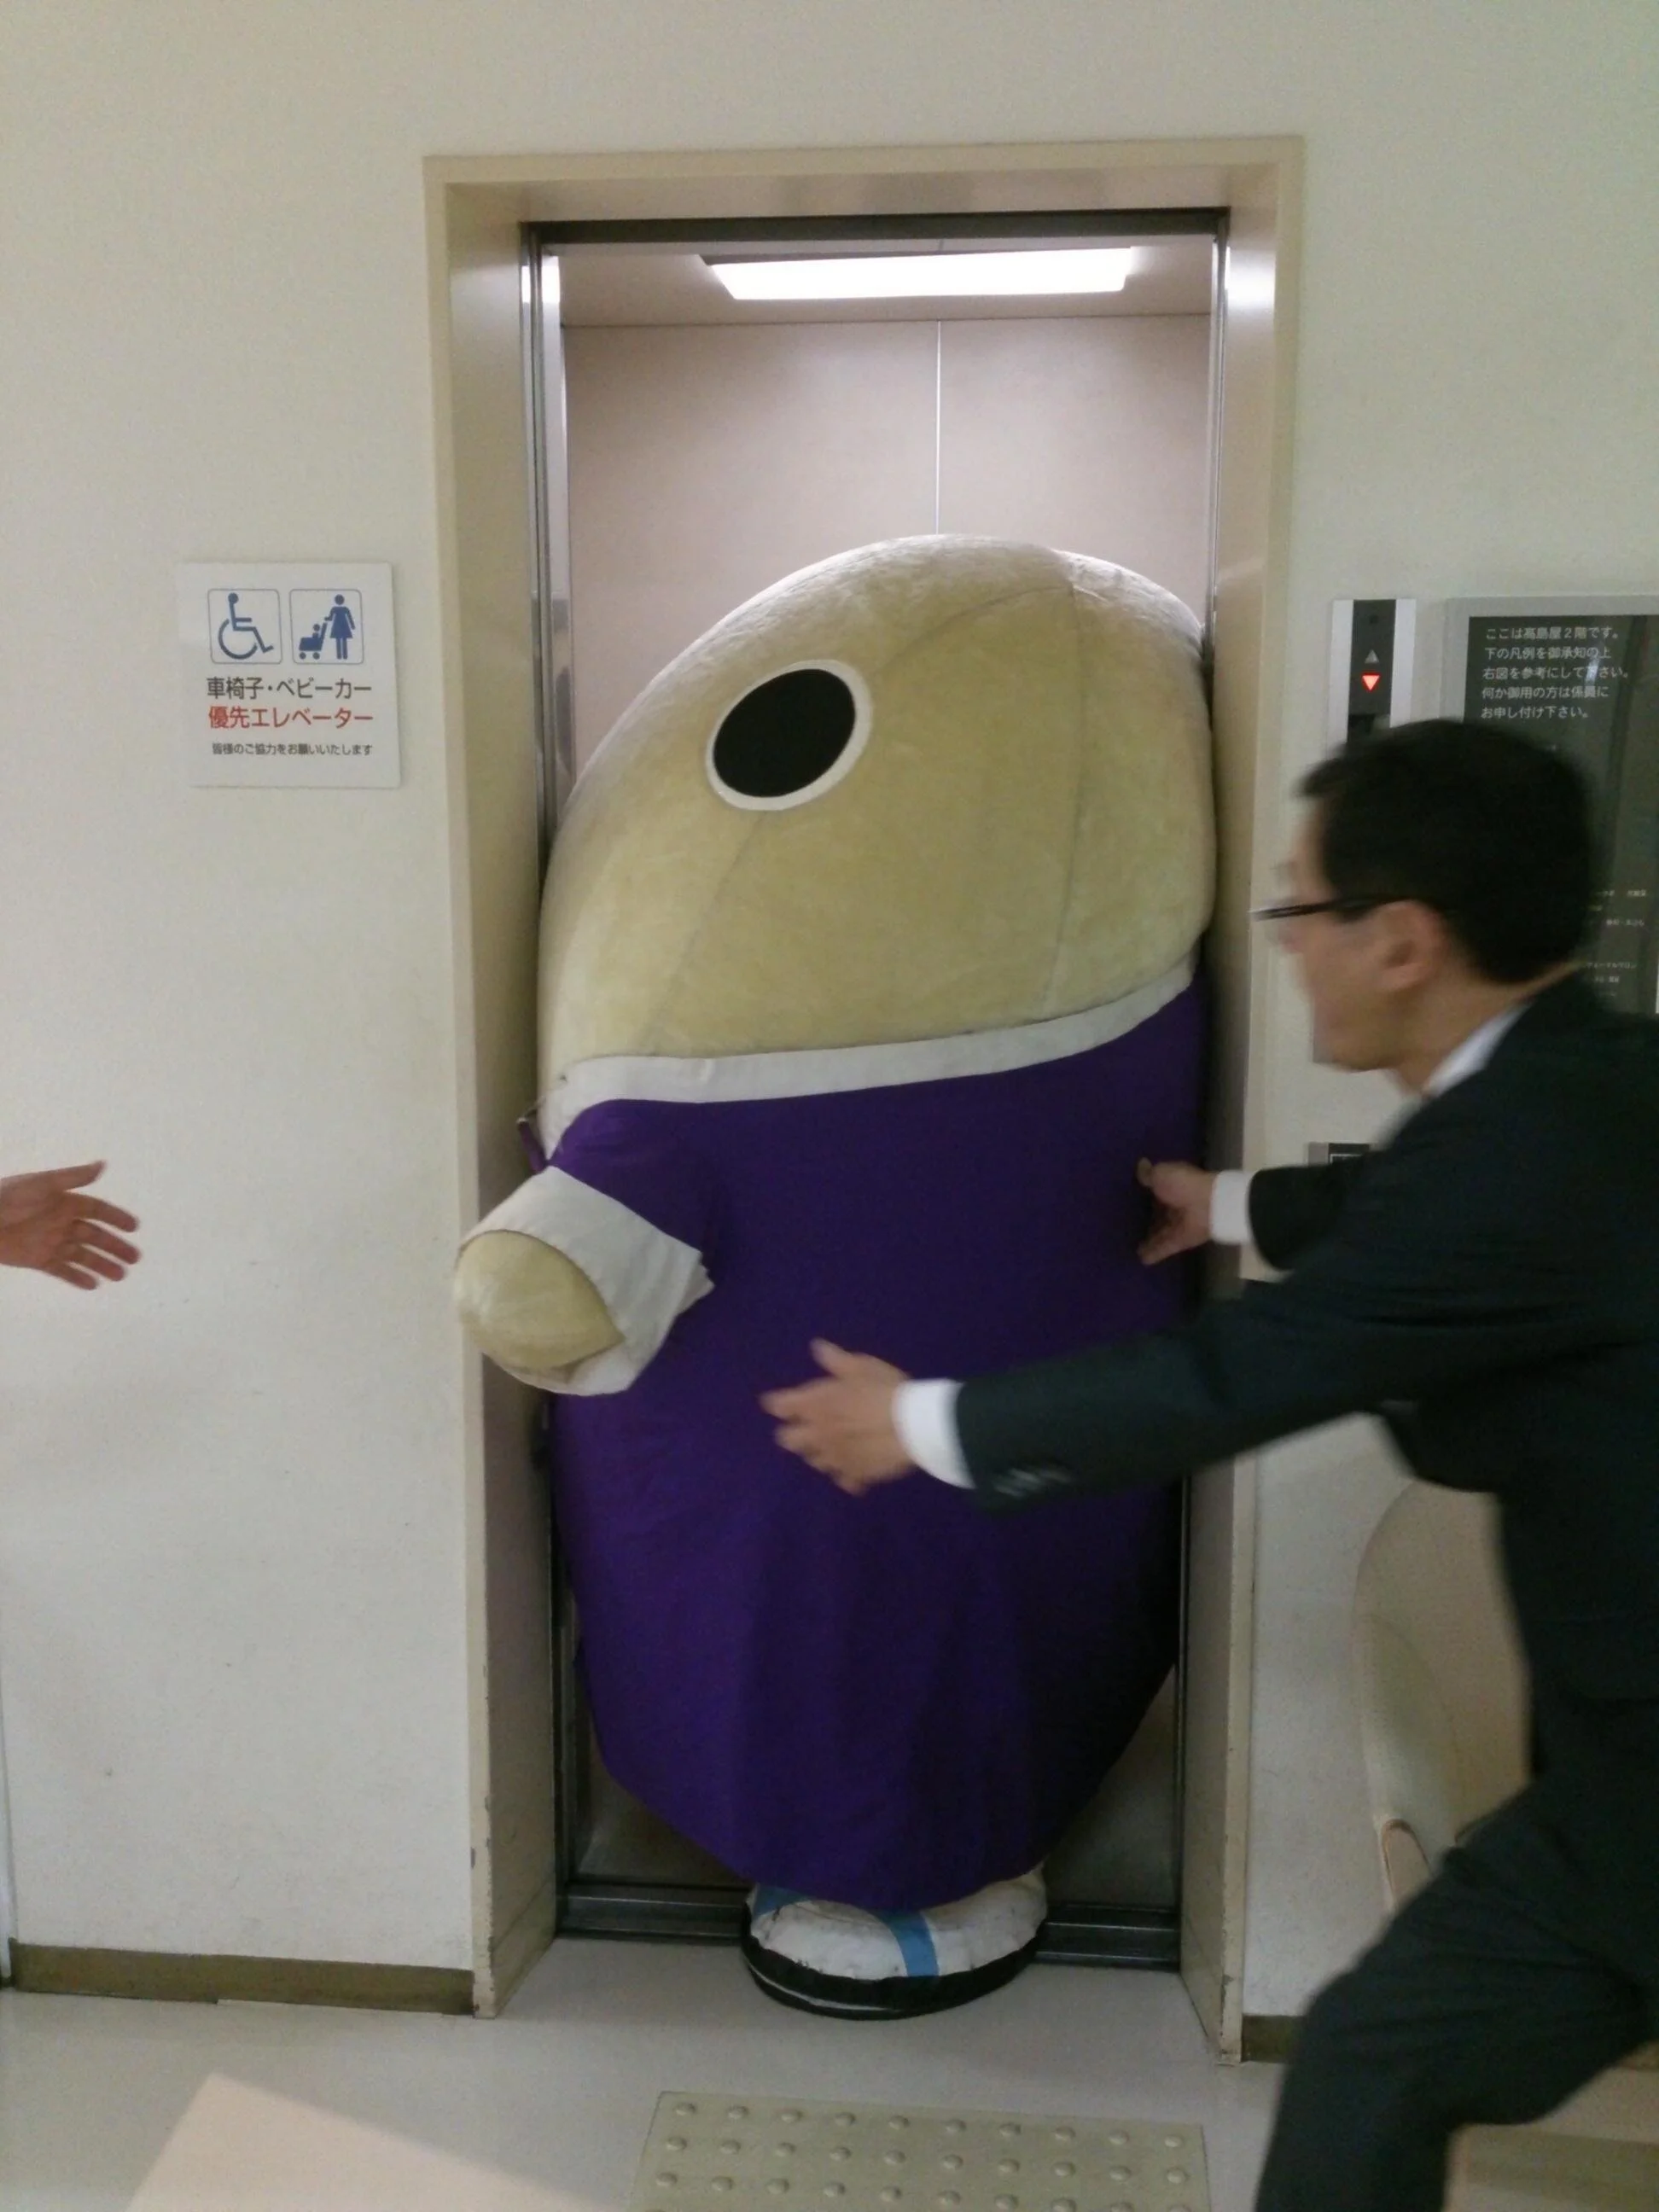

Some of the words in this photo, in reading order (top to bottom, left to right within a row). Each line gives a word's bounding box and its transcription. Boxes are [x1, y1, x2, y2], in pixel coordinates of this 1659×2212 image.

[1485, 647, 1611, 660] 下の凡例を御承知の上
[207, 676, 371, 700] 車椅子・ベビーカー
[1481, 686, 1610, 700] 何か御用の方は係員に
[209, 706, 374, 729] 優先エレベーター
[1481, 706, 1589, 719] お申し付け下さい。
[212, 743, 373, 756] 皆様のご協力をお願いいたします
